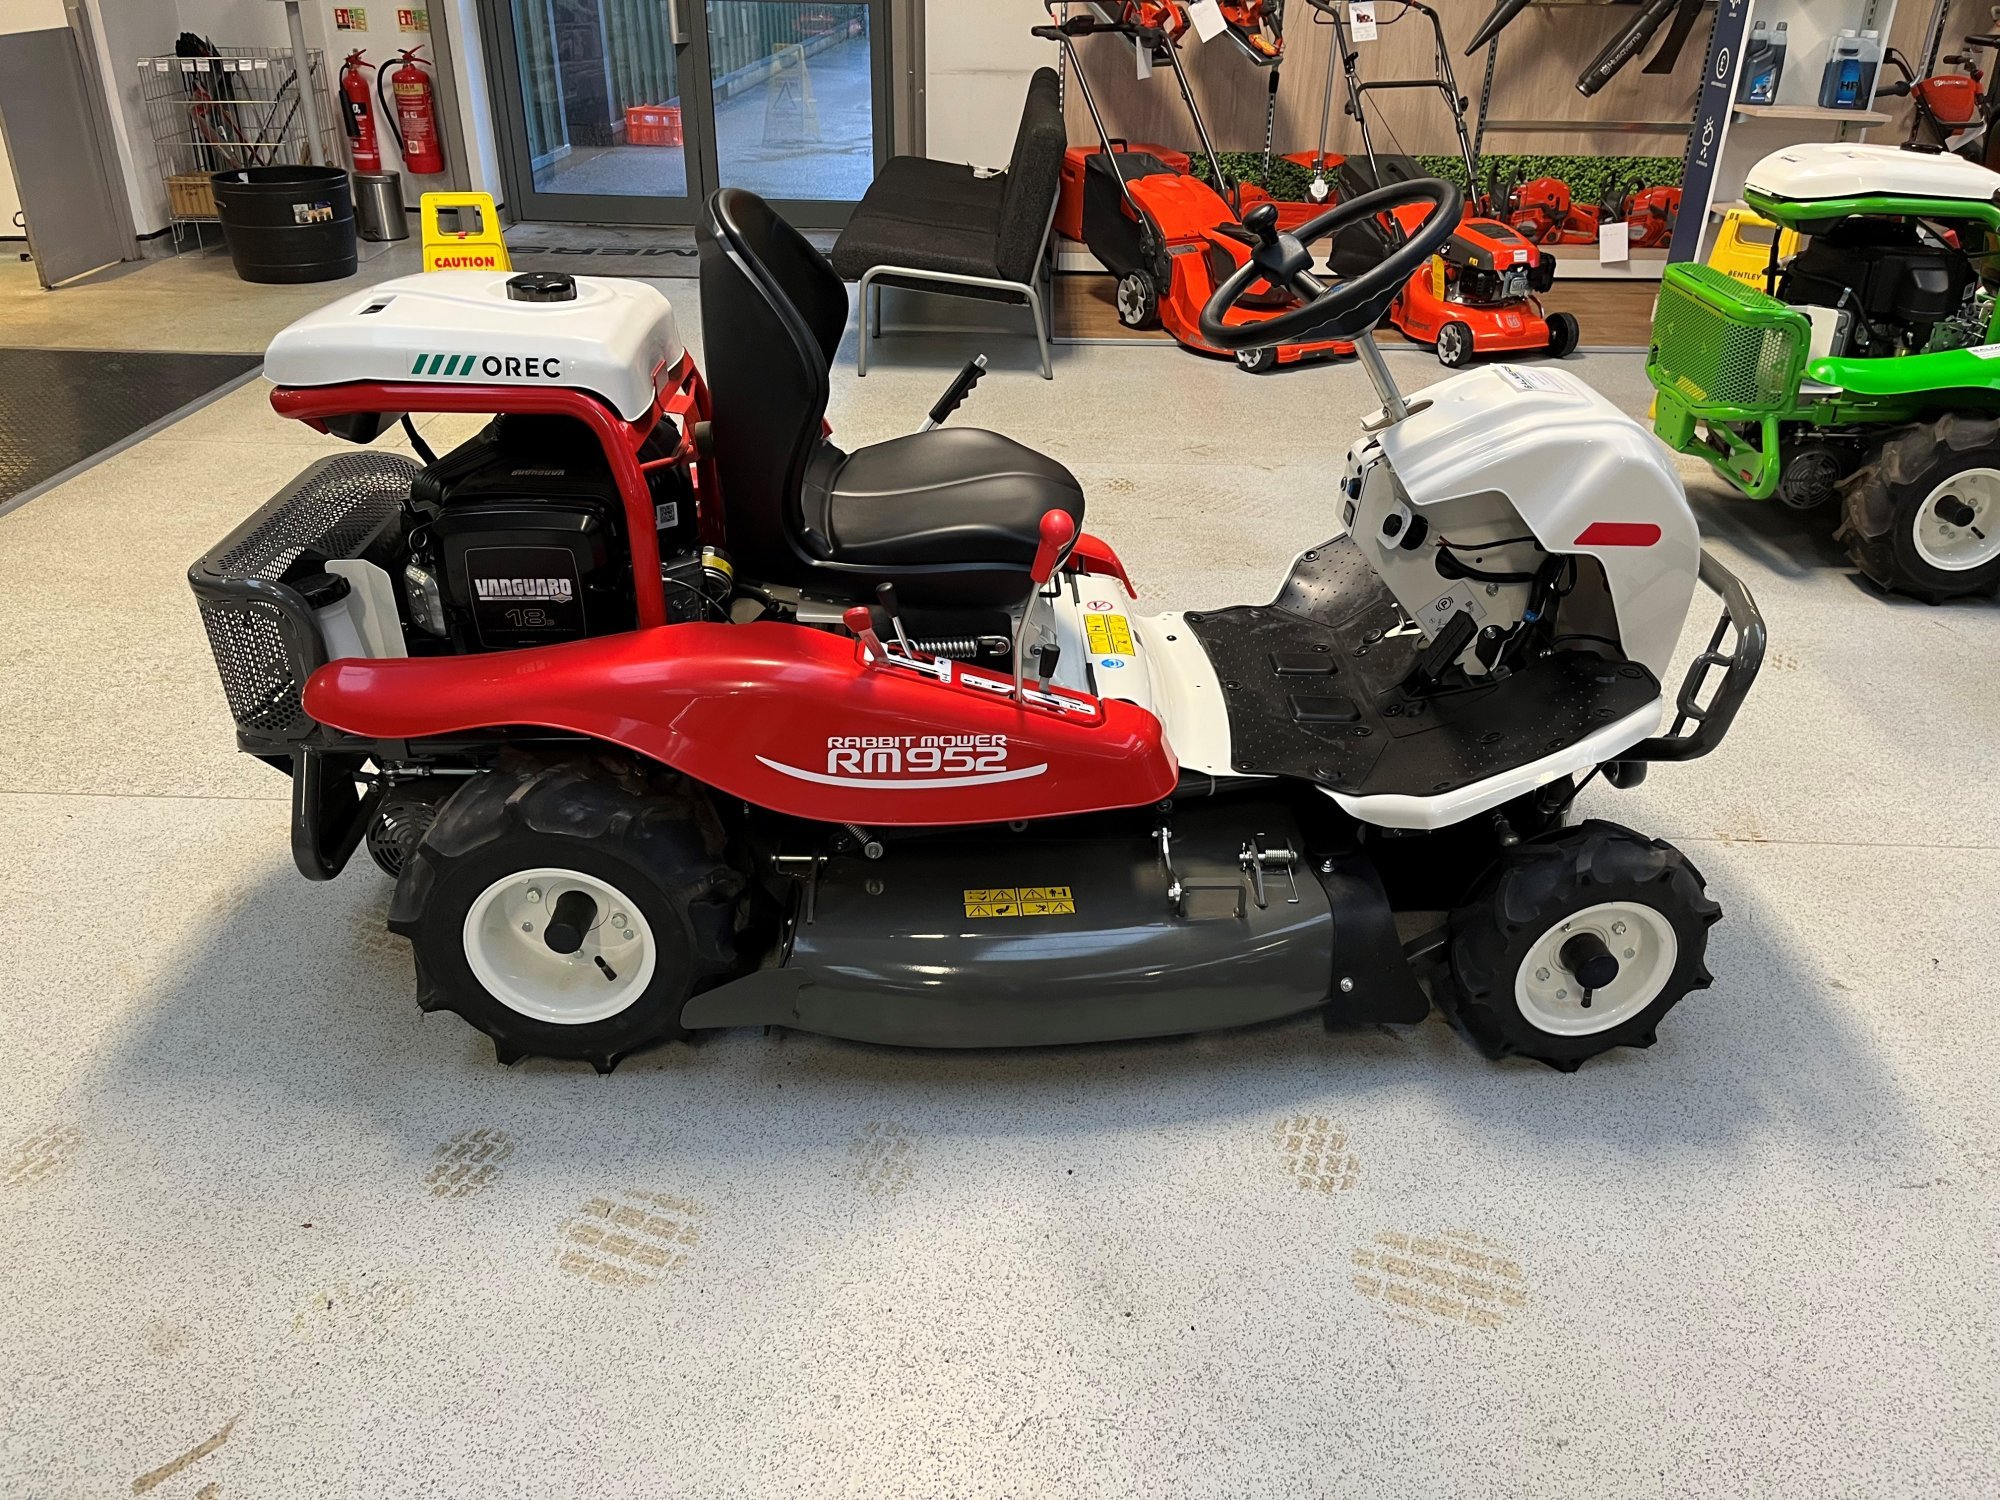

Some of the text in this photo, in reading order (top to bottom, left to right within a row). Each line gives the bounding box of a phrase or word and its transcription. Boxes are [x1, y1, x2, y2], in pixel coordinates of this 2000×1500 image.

[1607, 32, 1642, 69] Husqvarna
[1841, 81, 1859, 91] HP
[434, 256, 495, 268] CAUTION
[1728, 269, 1761, 280] BENTLEY
[482, 356, 561, 378] OREC
[474, 579, 573, 596] VANGUARD
[505, 609, 546, 626] 18
[827, 734, 1007, 748] RABBIT MOWER
[827, 747, 1008, 773] RM952
